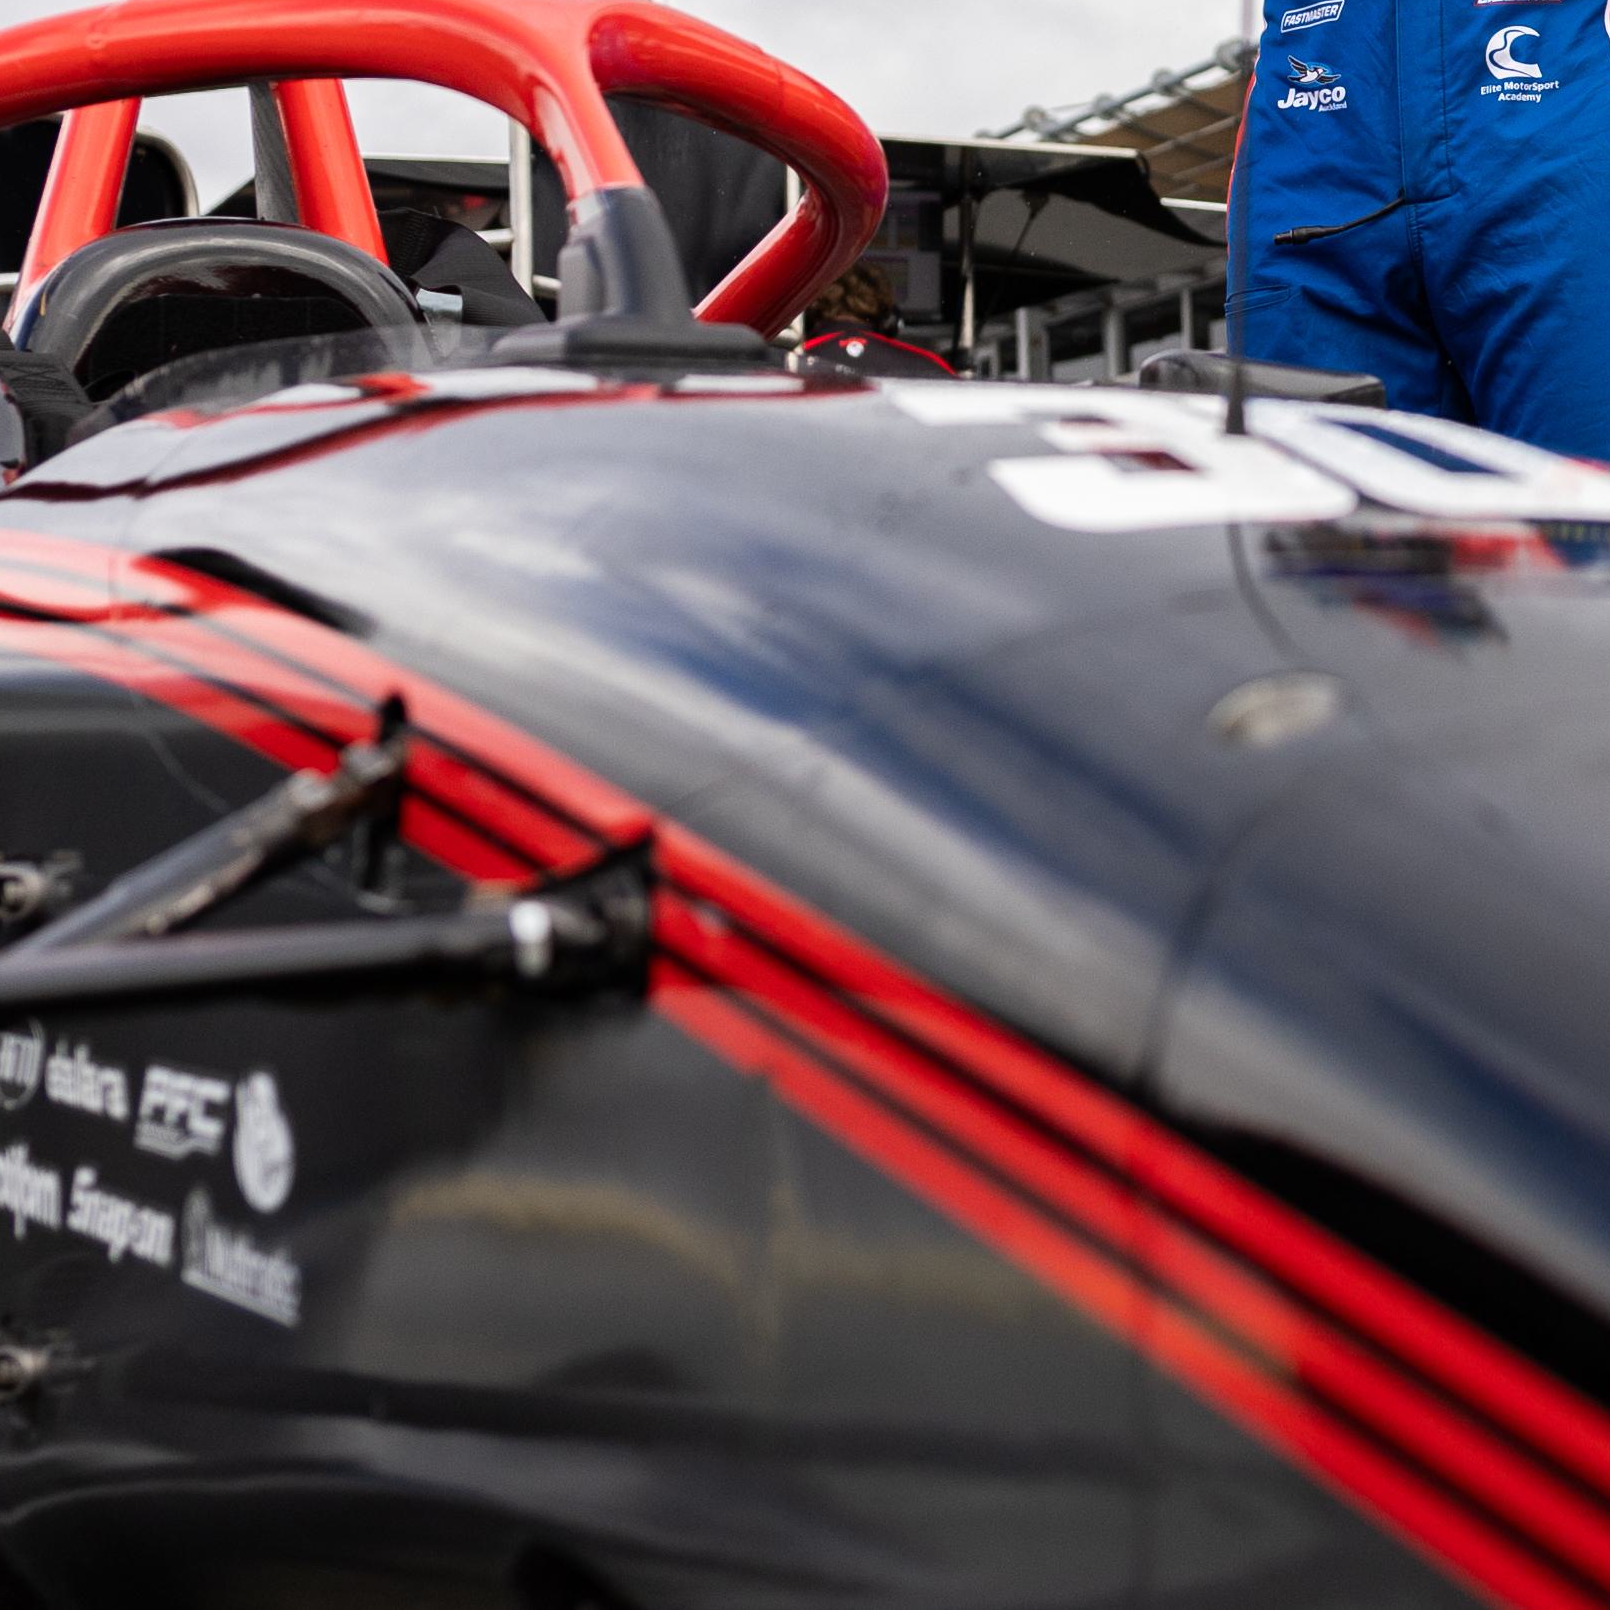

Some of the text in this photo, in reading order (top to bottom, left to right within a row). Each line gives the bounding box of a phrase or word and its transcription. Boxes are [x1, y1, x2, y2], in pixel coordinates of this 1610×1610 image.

[1283, 4, 1340, 27] FASTMASTER
[1480, 80, 1559, 95] Elite MotorSport
[1277, 86, 1346, 111] Jayco
[1497, 92, 1542, 103] Academy
